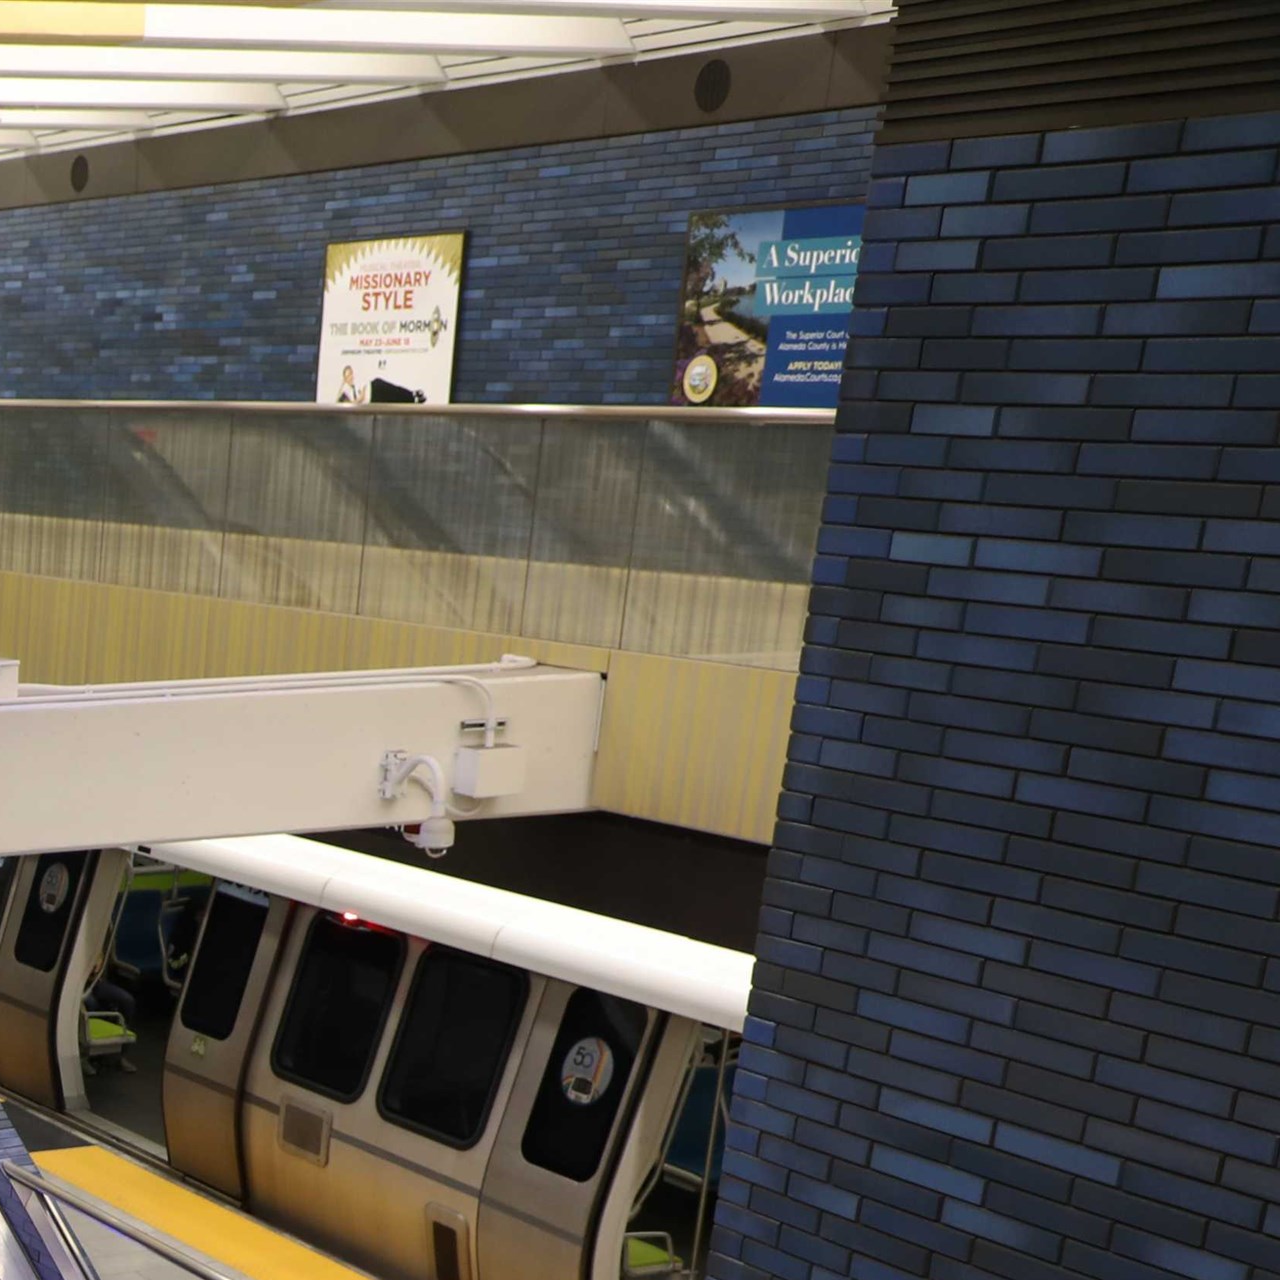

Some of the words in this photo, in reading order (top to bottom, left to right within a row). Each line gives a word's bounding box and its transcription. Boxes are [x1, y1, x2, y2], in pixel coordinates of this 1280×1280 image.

[762, 244, 779, 268] A
[349, 271, 431, 290] MISSIONARY
[361, 291, 414, 311] STYLE
[330, 323, 348, 335] THE
[351, 322, 378, 335] BOOK
[382, 320, 397, 334] OF
[799, 330, 825, 341] Superior
[826, 330, 845, 339] Court
[778, 342, 806, 351] Alameda
[807, 341, 830, 352] County
[787, 361, 813, 370] APPLY
[574, 1046, 594, 1068] 50
